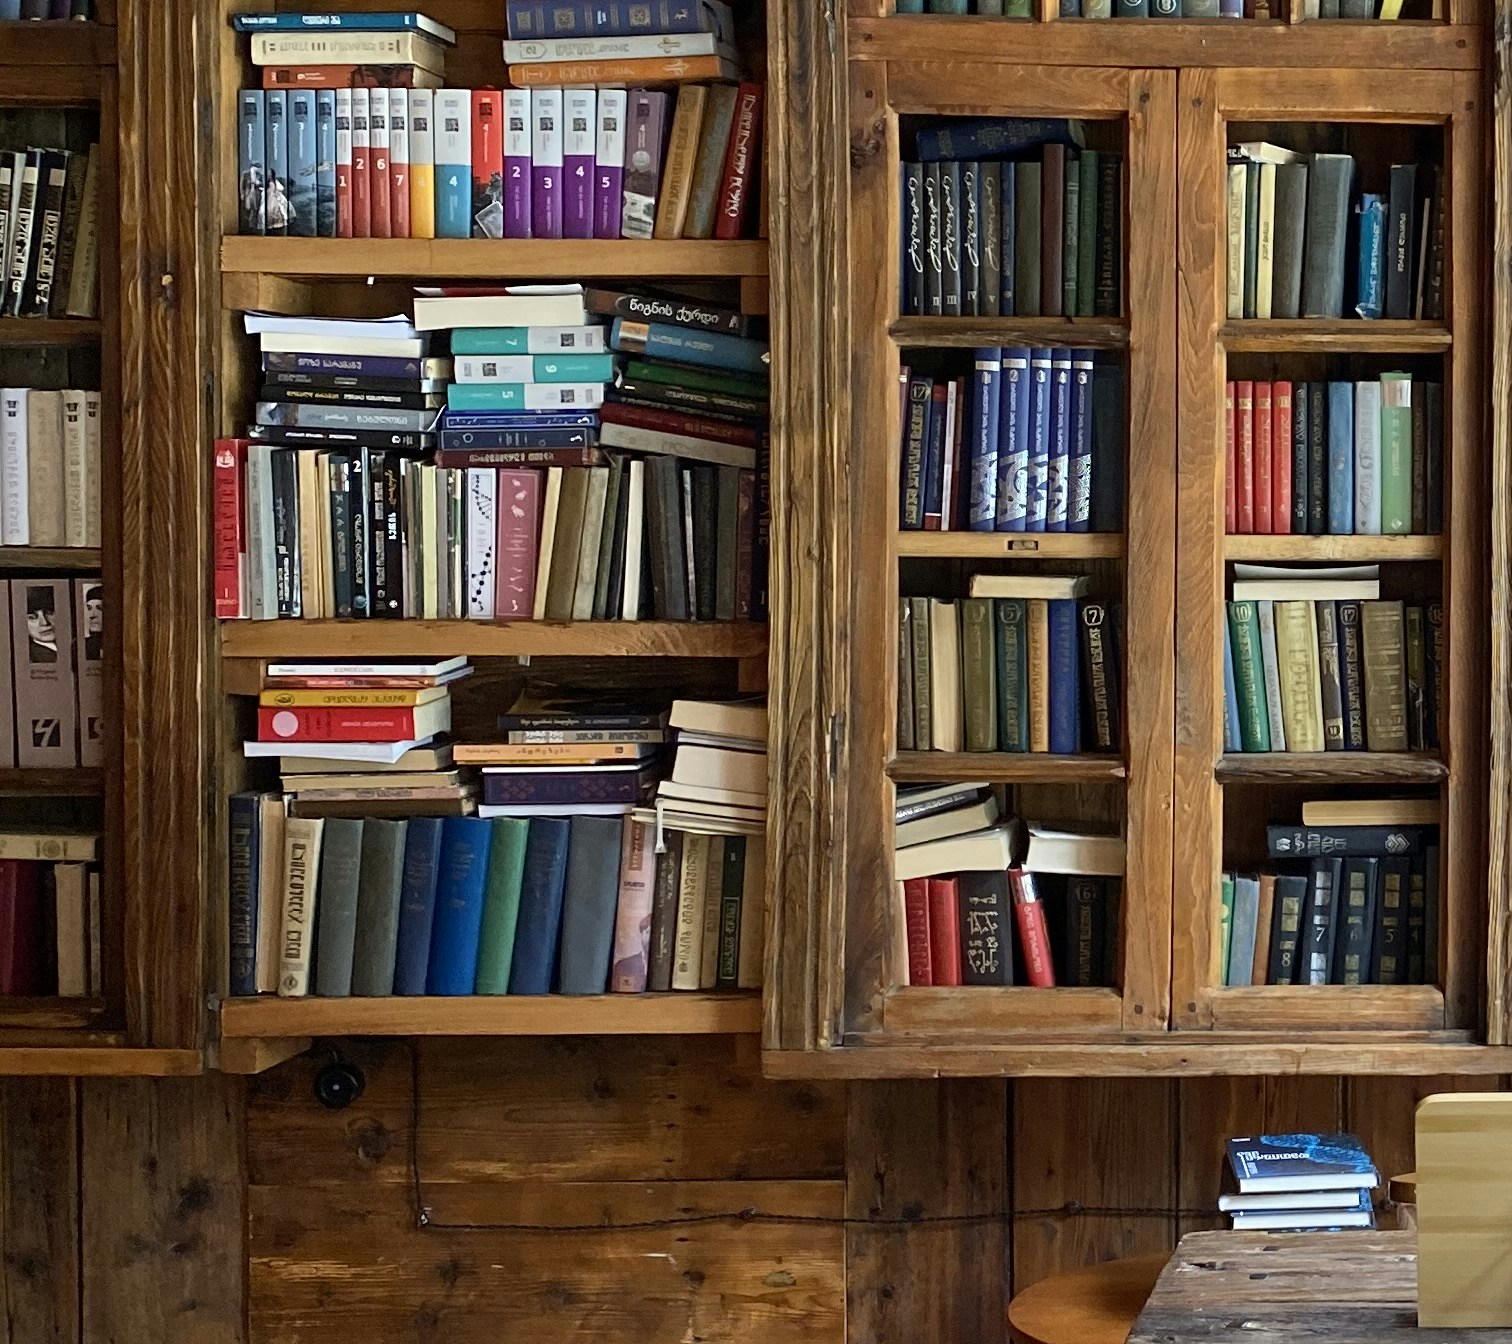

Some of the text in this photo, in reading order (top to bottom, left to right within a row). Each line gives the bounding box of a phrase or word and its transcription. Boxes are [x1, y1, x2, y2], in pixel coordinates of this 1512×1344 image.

[248, 123, 253, 131] 1
[273, 123, 279, 131] 2
[298, 122, 304, 131] 3
[322, 123, 328, 131] 4
[483, 123, 489, 131] 4
[640, 124, 646, 132] 4
[356, 158, 365, 170] 2
[376, 158, 386, 170] 6
[512, 166, 521, 178] 2
[575, 166, 585, 177] 4
[339, 175, 347, 187] 1
[395, 175, 404, 186] 7
[450, 176, 458, 186] 4
[543, 177, 552, 189] 3
[601, 176, 611, 188] 5
[629, 298, 719, 325] წიგნის ქურდი
[505, 338, 518, 346] 7
[502, 390, 514, 398] 5
[912, 385, 926, 397] 17
[353, 460, 362, 472] 2
[1088, 610, 1098, 623] 7
[1236, 606, 1248, 619] 10
[1315, 927, 1326, 942] 7
[1350, 931, 1358, 942] 6
[1385, 928, 1394, 943] 5
[678, 931, 692, 961] იაკობ
[1281, 952, 1291, 967] 8
